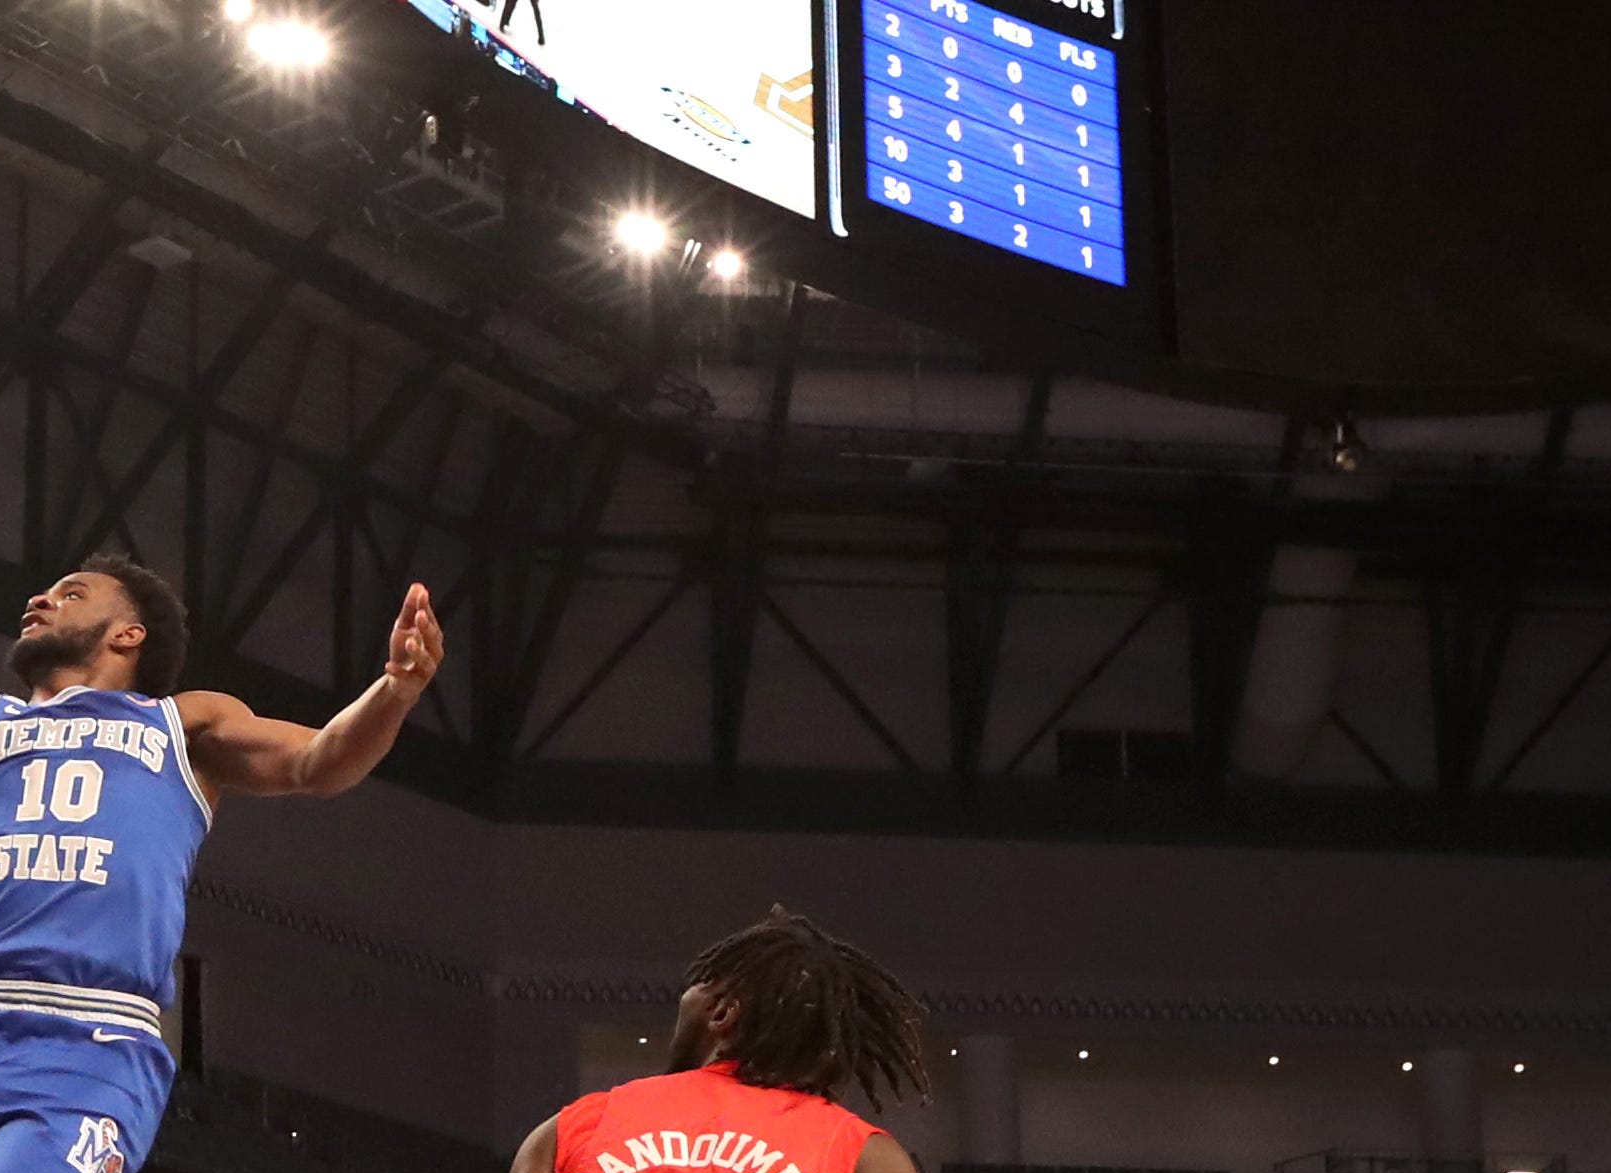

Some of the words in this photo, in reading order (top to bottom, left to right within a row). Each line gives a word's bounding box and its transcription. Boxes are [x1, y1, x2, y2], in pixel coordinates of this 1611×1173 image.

[885, 13, 900, 38] 2
[942, 36, 959, 59] 0
[1006, 61, 1023, 84] 0
[1071, 84, 1087, 107] 0
[887, 54, 902, 78] 3
[945, 76, 960, 101] 2
[1008, 102, 1025, 125] 4
[1076, 125, 1088, 147] 1
[883, 135, 908, 162] 10
[947, 159, 963, 183] 3
[1014, 184, 1025, 206] 1
[1079, 205, 1091, 228] 1
[888, 95, 904, 119] 5
[946, 119, 962, 142] 4
[1012, 143, 1024, 165] 1
[1077, 165, 1089, 187] 1
[883, 176, 911, 205] 50
[949, 201, 964, 224] 3
[1014, 223, 1028, 248] 2
[1081, 246, 1093, 269] 1
[15, 759, 104, 823] 10
